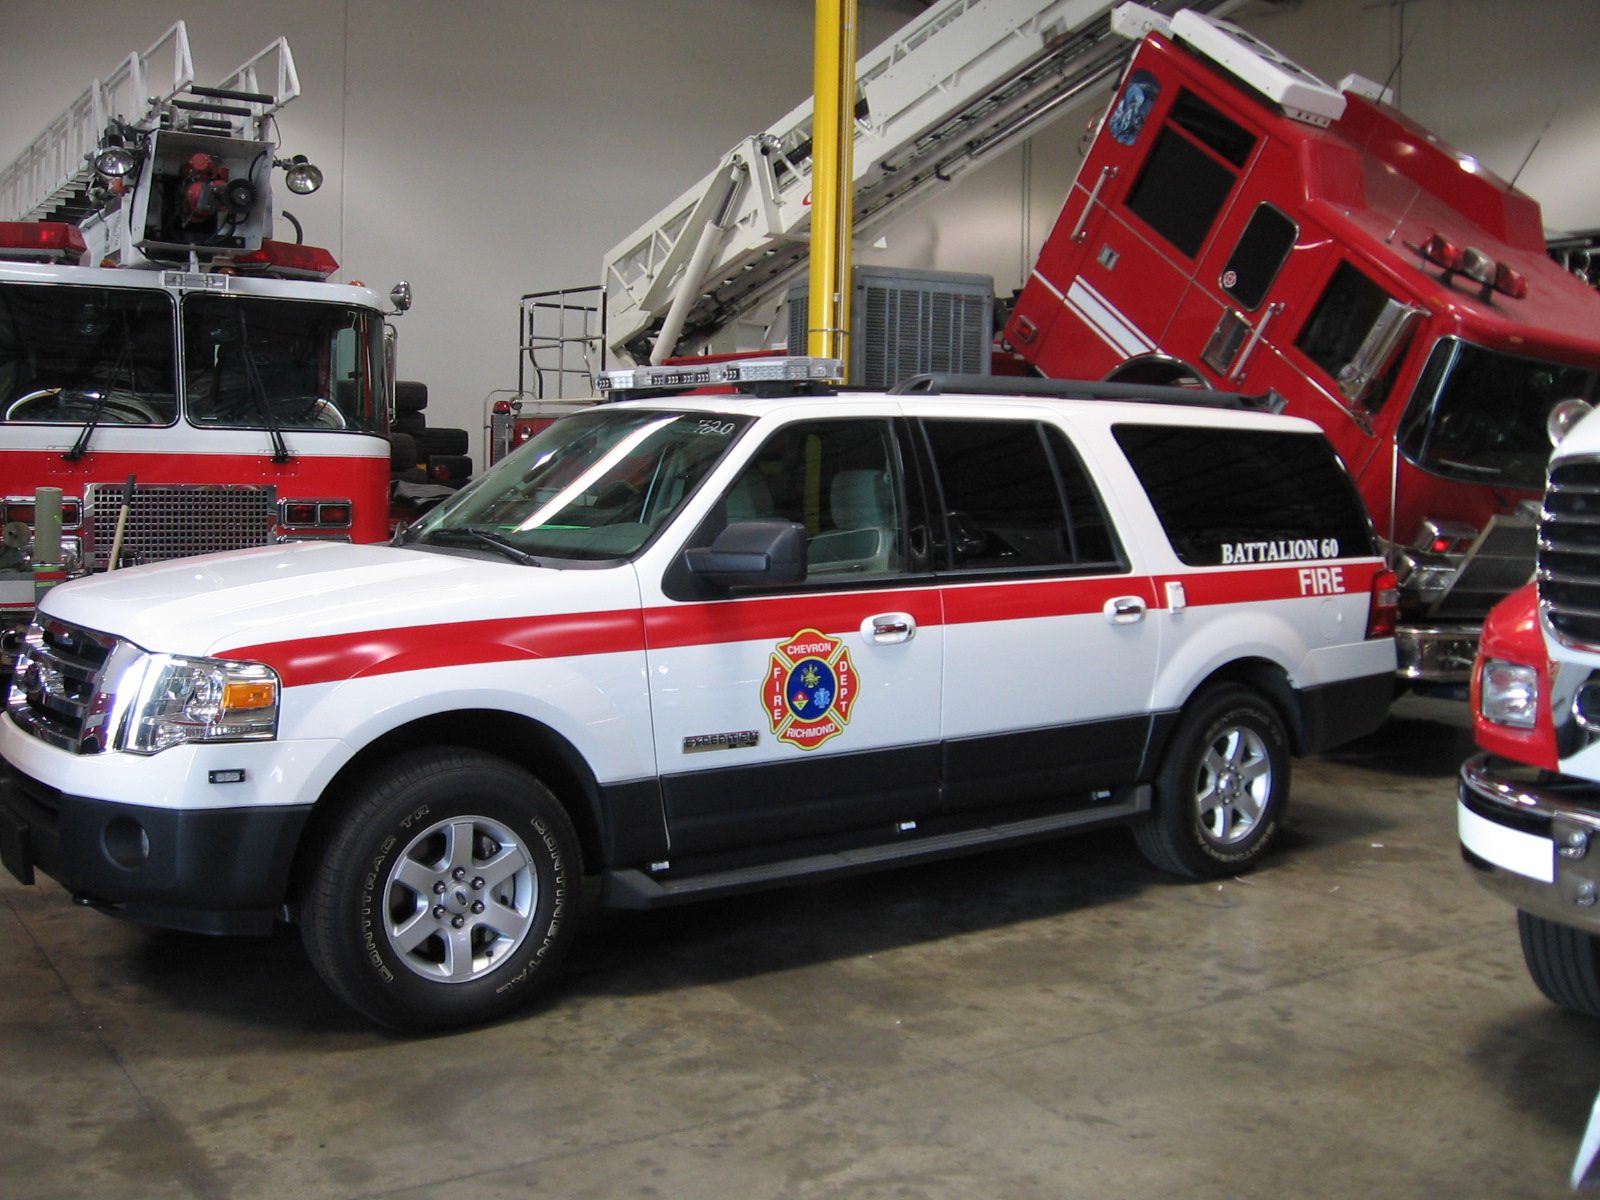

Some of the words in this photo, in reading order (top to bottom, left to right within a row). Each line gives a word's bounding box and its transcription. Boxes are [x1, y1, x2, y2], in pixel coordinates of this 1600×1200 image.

[1221, 539, 1318, 564] BATTALION
[1321, 538, 1339, 558] 60
[1298, 567, 1346, 595] FIRE
[787, 643, 832, 655] CHEVRON
[773, 667, 782, 720] FIRE
[840, 661, 848, 712] DEPT
[683, 731, 759, 748] EXPEDITION
[786, 723, 836, 738] RICHMOND
[496, 816, 567, 993] CONTINENTAL
